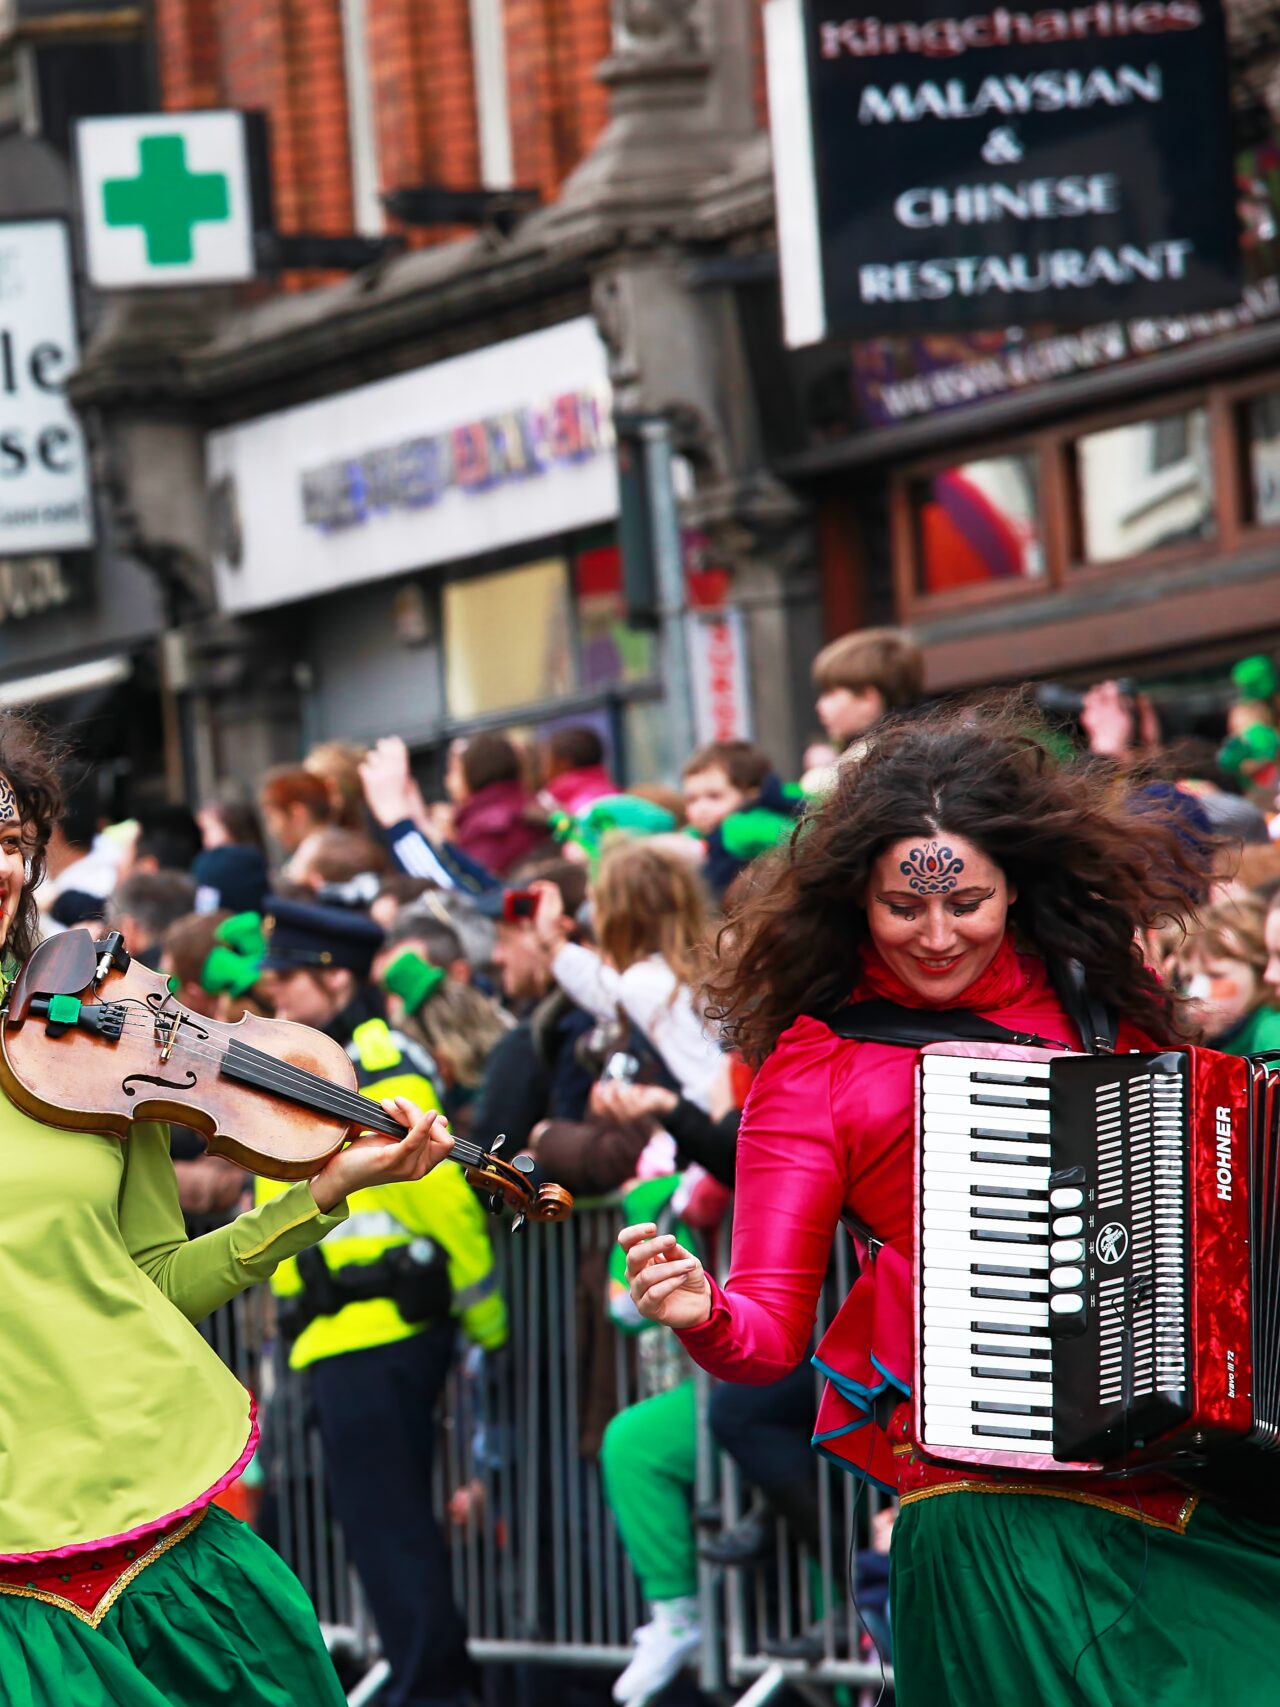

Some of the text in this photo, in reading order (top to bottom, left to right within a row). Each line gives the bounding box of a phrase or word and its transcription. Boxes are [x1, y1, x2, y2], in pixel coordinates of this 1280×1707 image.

[821, 1, 1203, 59] Kingcharlies
[858, 62, 1163, 124] MALAYSIAN
[982, 126, 1024, 166] &
[894, 172, 1119, 230] CHINESE
[859, 239, 1192, 304] RESTAURANT
[1216, 1106, 1233, 1202] HOHNER
[1226, 1350, 1235, 1361] 72
[1227, 1372, 1236, 1399] bravo
